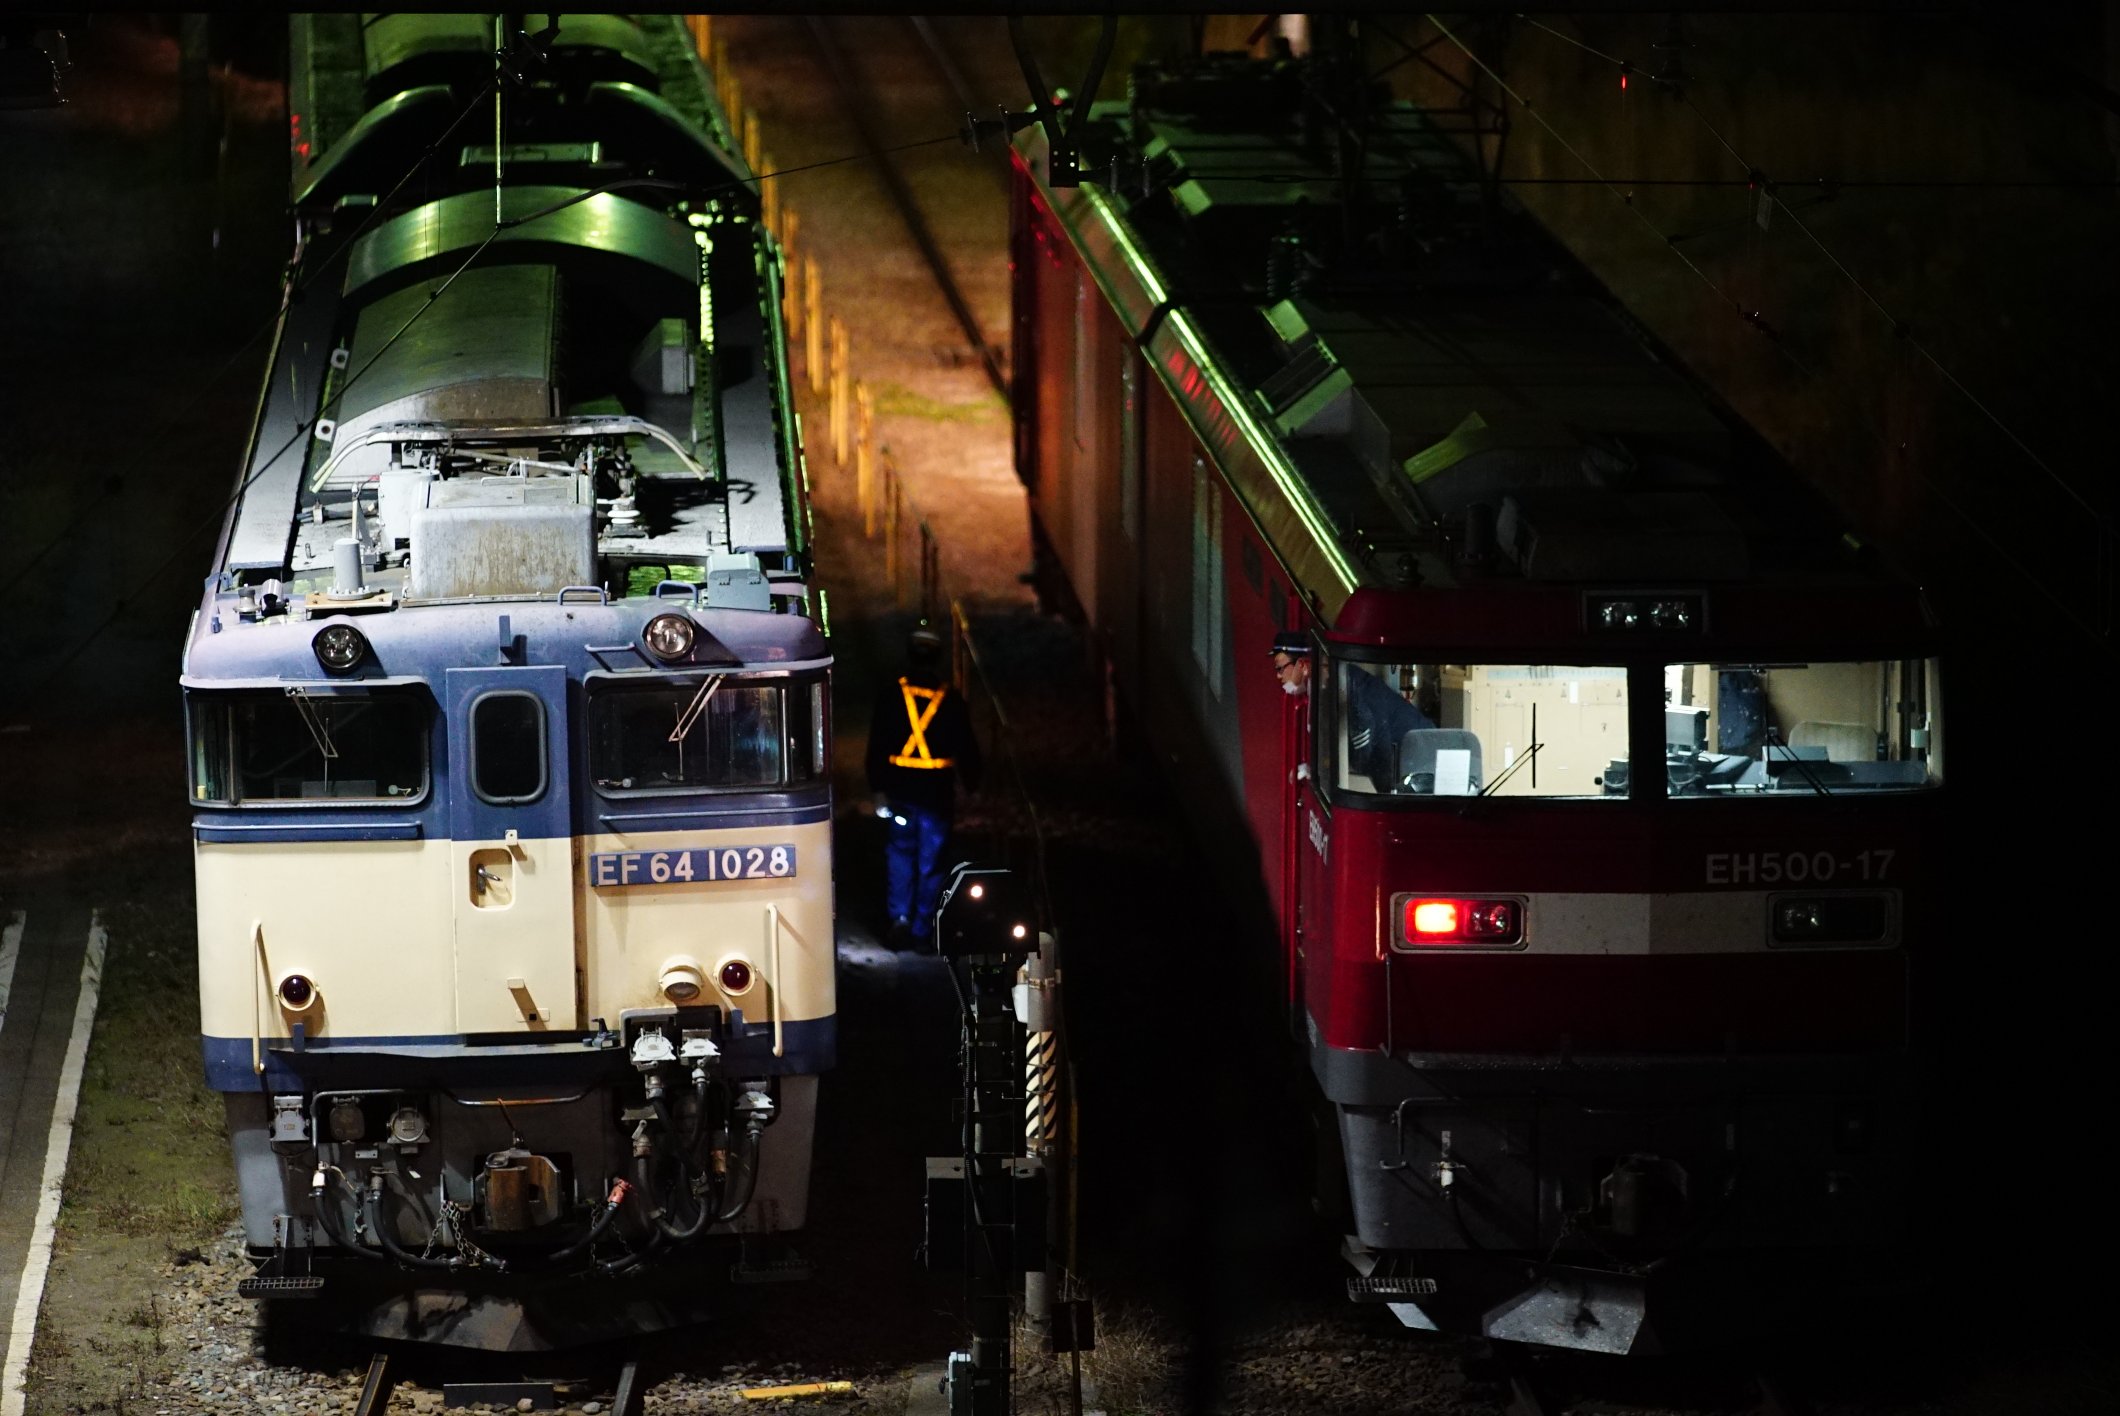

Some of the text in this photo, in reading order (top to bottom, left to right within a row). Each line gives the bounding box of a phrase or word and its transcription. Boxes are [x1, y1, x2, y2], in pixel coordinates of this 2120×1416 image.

[597, 846, 789, 886] EF 64 1028
[1705, 849, 1896, 884] EH500-17
